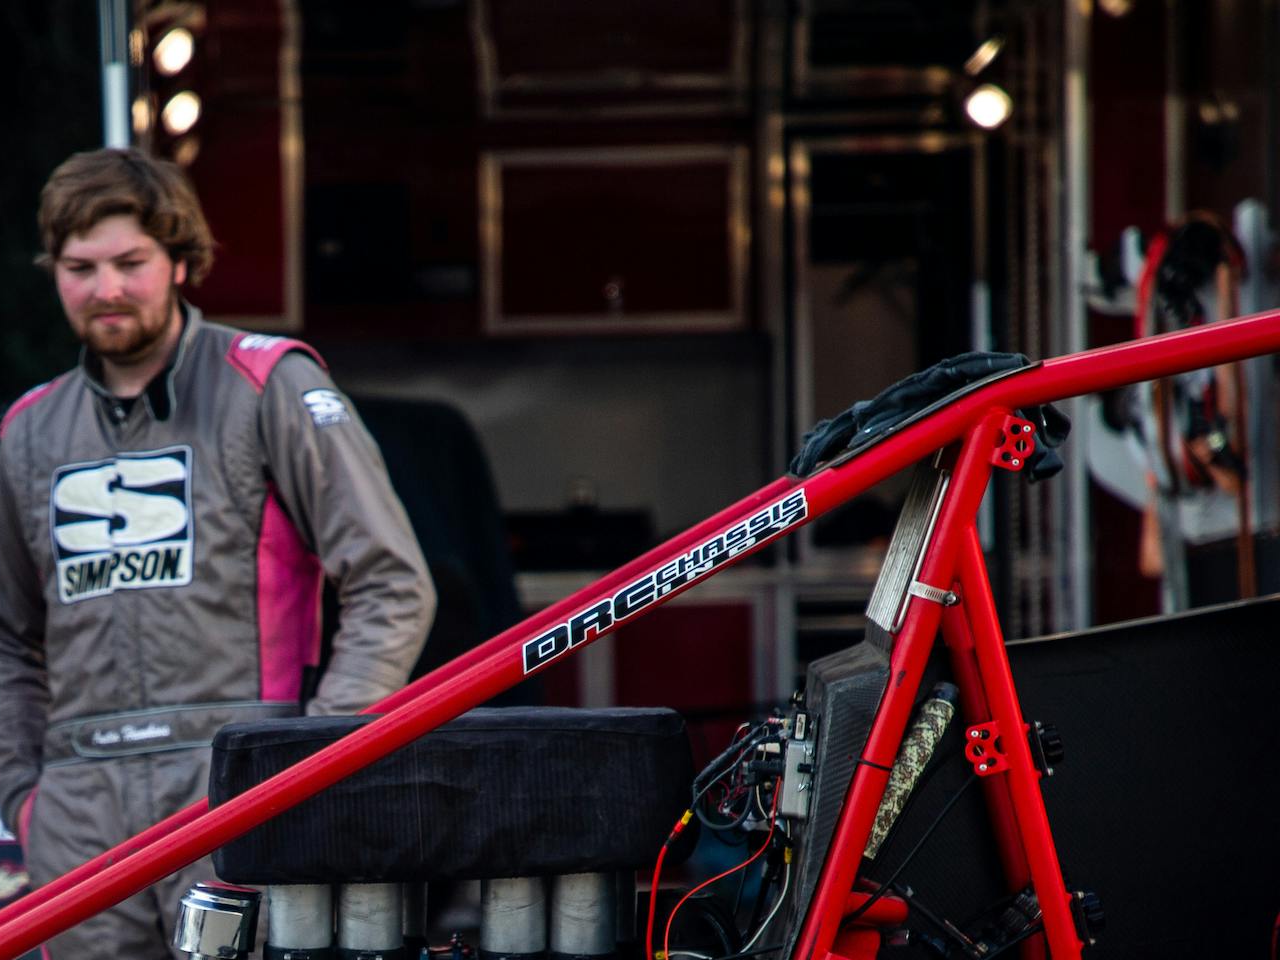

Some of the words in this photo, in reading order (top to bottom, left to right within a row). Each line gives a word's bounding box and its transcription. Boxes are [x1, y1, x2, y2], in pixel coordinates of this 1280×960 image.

[54, 457, 188, 552] S
[65, 548, 183, 597] SIMPSON
[523, 572, 656, 674] DRC
[655, 488, 807, 587] CHASSIS
